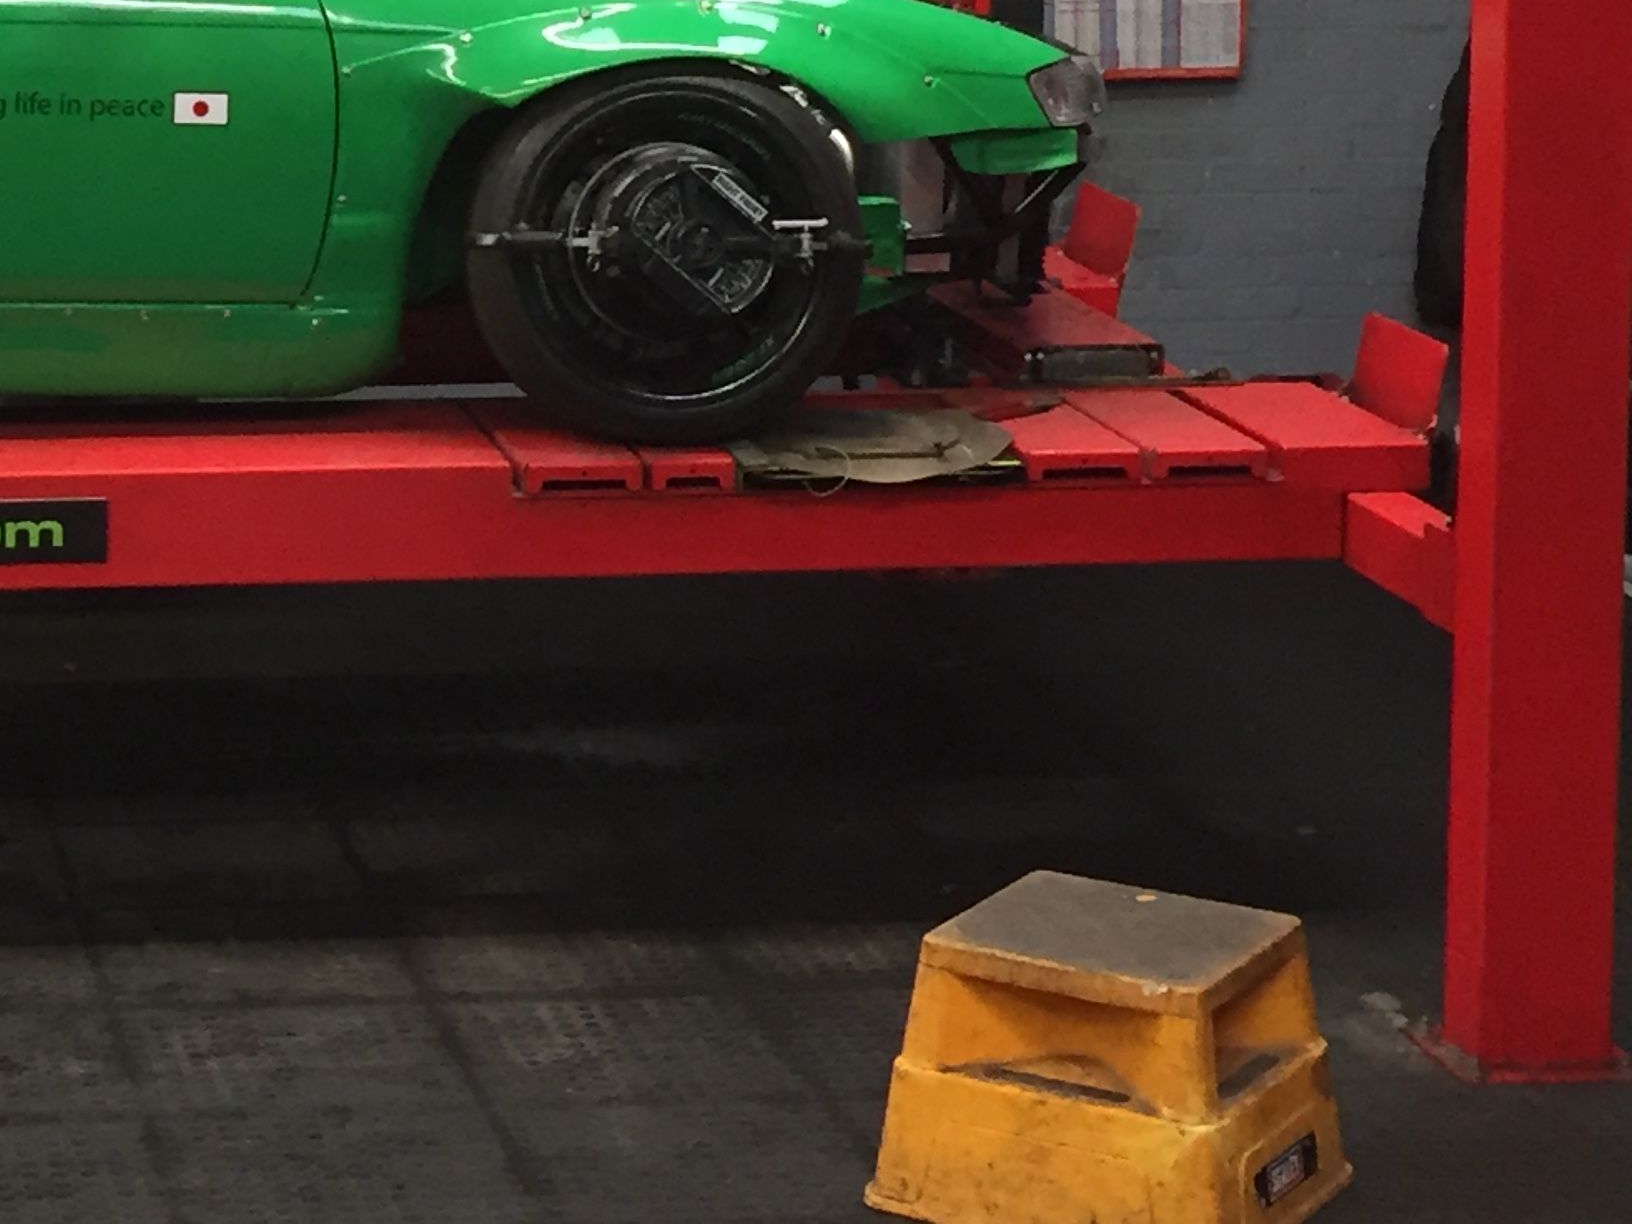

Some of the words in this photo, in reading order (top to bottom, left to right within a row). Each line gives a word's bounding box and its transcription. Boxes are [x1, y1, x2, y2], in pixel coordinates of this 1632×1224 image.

[15, 92, 52, 116] life
[59, 93, 82, 116] in
[89, 99, 166, 121] peace
